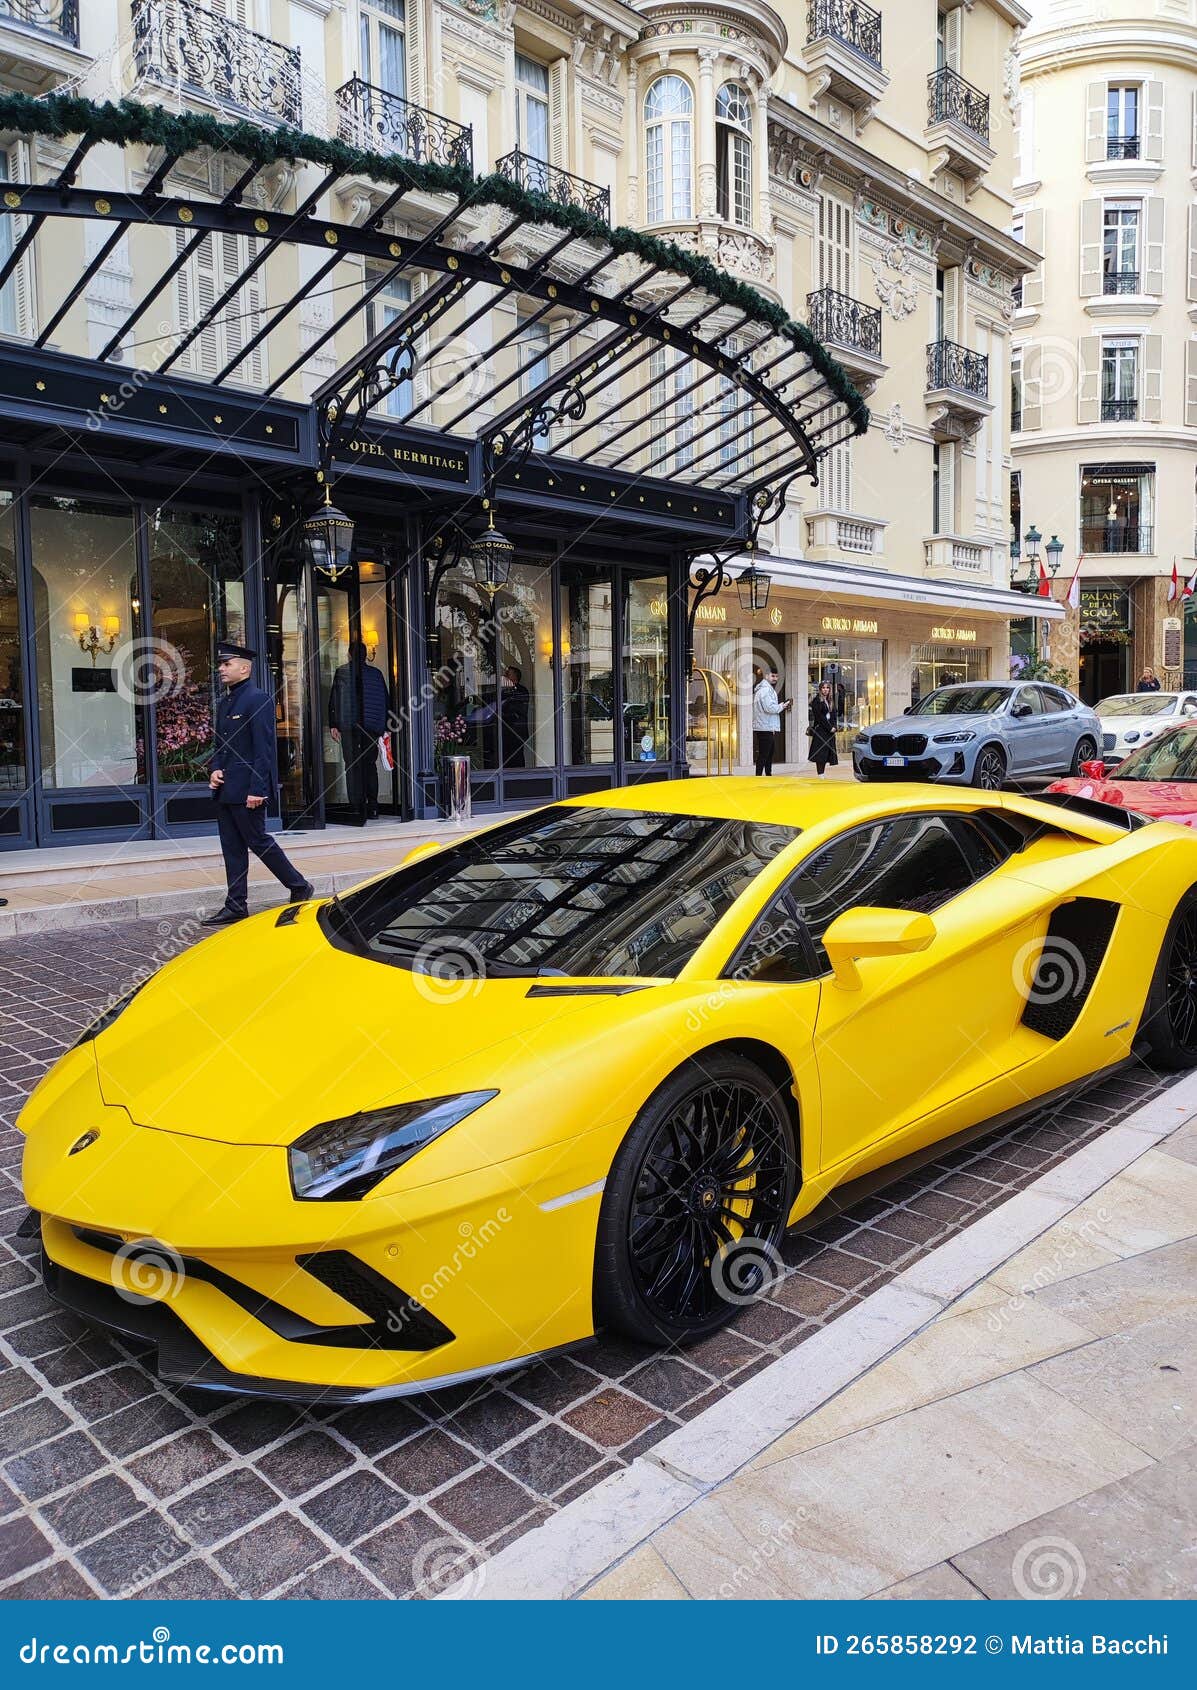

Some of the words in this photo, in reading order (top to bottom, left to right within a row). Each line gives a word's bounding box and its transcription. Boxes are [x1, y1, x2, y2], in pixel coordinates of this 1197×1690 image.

[348, 440, 385, 456] OTEL
[394, 449, 464, 471] HERMITAGE
[1081, 592, 1120, 601] PALAIS
[1082, 609, 1119, 617] SCALA
[821, 616, 851, 631] GIORGIO
[852, 619, 878, 634] ARMANI
